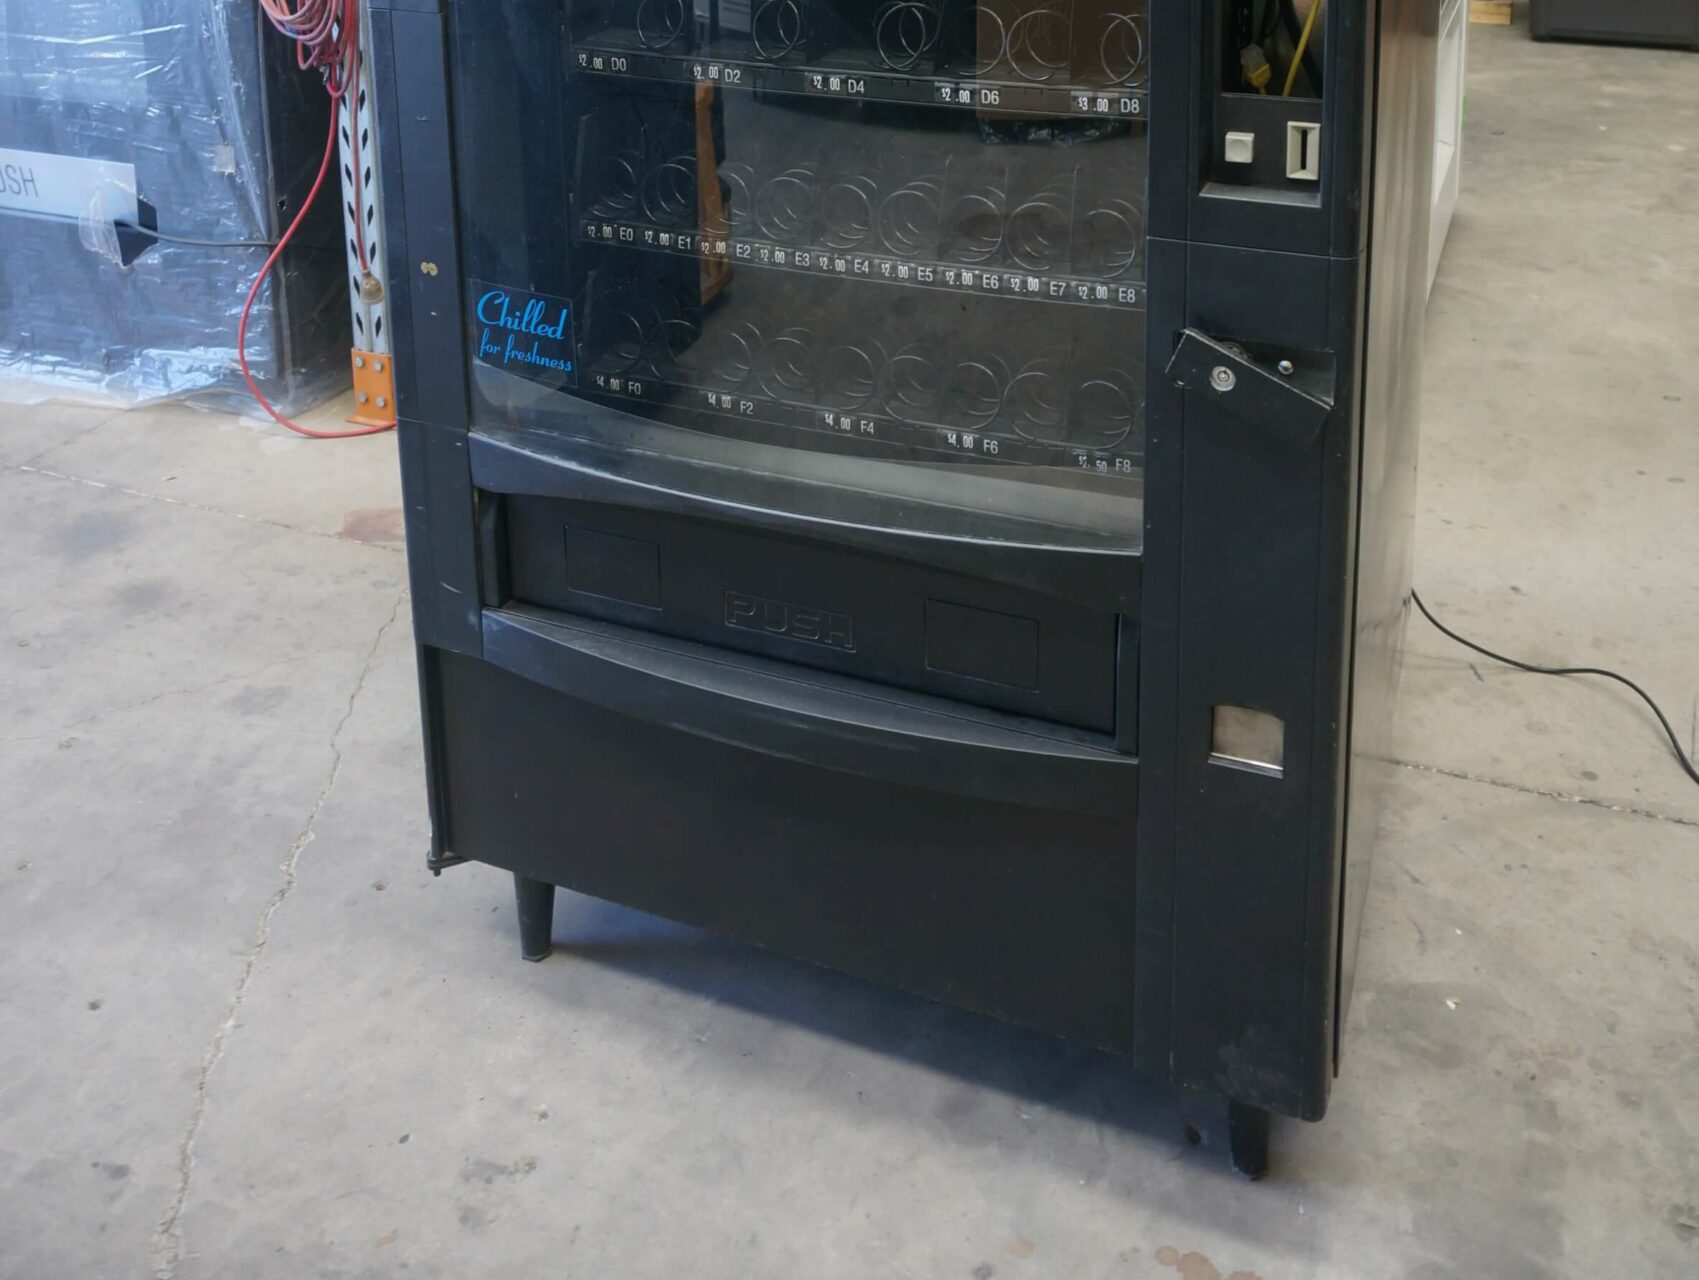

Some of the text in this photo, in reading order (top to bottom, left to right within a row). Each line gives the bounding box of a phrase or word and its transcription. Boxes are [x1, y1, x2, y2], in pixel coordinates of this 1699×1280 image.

[578, 54, 627, 72] $2.00 D0
[694, 66, 741, 83] $2.00 D2
[813, 76, 865, 94] $2.00 D4
[942, 88, 1000, 105] $2.00 D6
[1120, 98, 1140, 114] D8
[588, 226, 634, 242] $2.00 E0
[644, 231, 692, 250] $2.00 E1
[701, 242, 752, 258] $2.00 E2
[760, 249, 810, 267] $2.00 E3
[819, 256, 870, 274] $2.00 E4
[881, 262, 934, 282] $2.00 E5
[946, 270, 999, 290] $2.00 E6
[1010, 278, 1066, 296] $2.00 E7
[1078, 285, 1136, 303] $2.00 E8
[477, 291, 568, 340] Chilled
[480, 328, 573, 372] for freshness
[628, 381, 642, 396] F0
[708, 393, 754, 416] $4.00 F2
[824, 413, 874, 434] $4.00 F4
[947, 433, 999, 455] $4.00 F6
[1115, 458, 1132, 474] F8
[728, 600, 854, 648] PUSH
